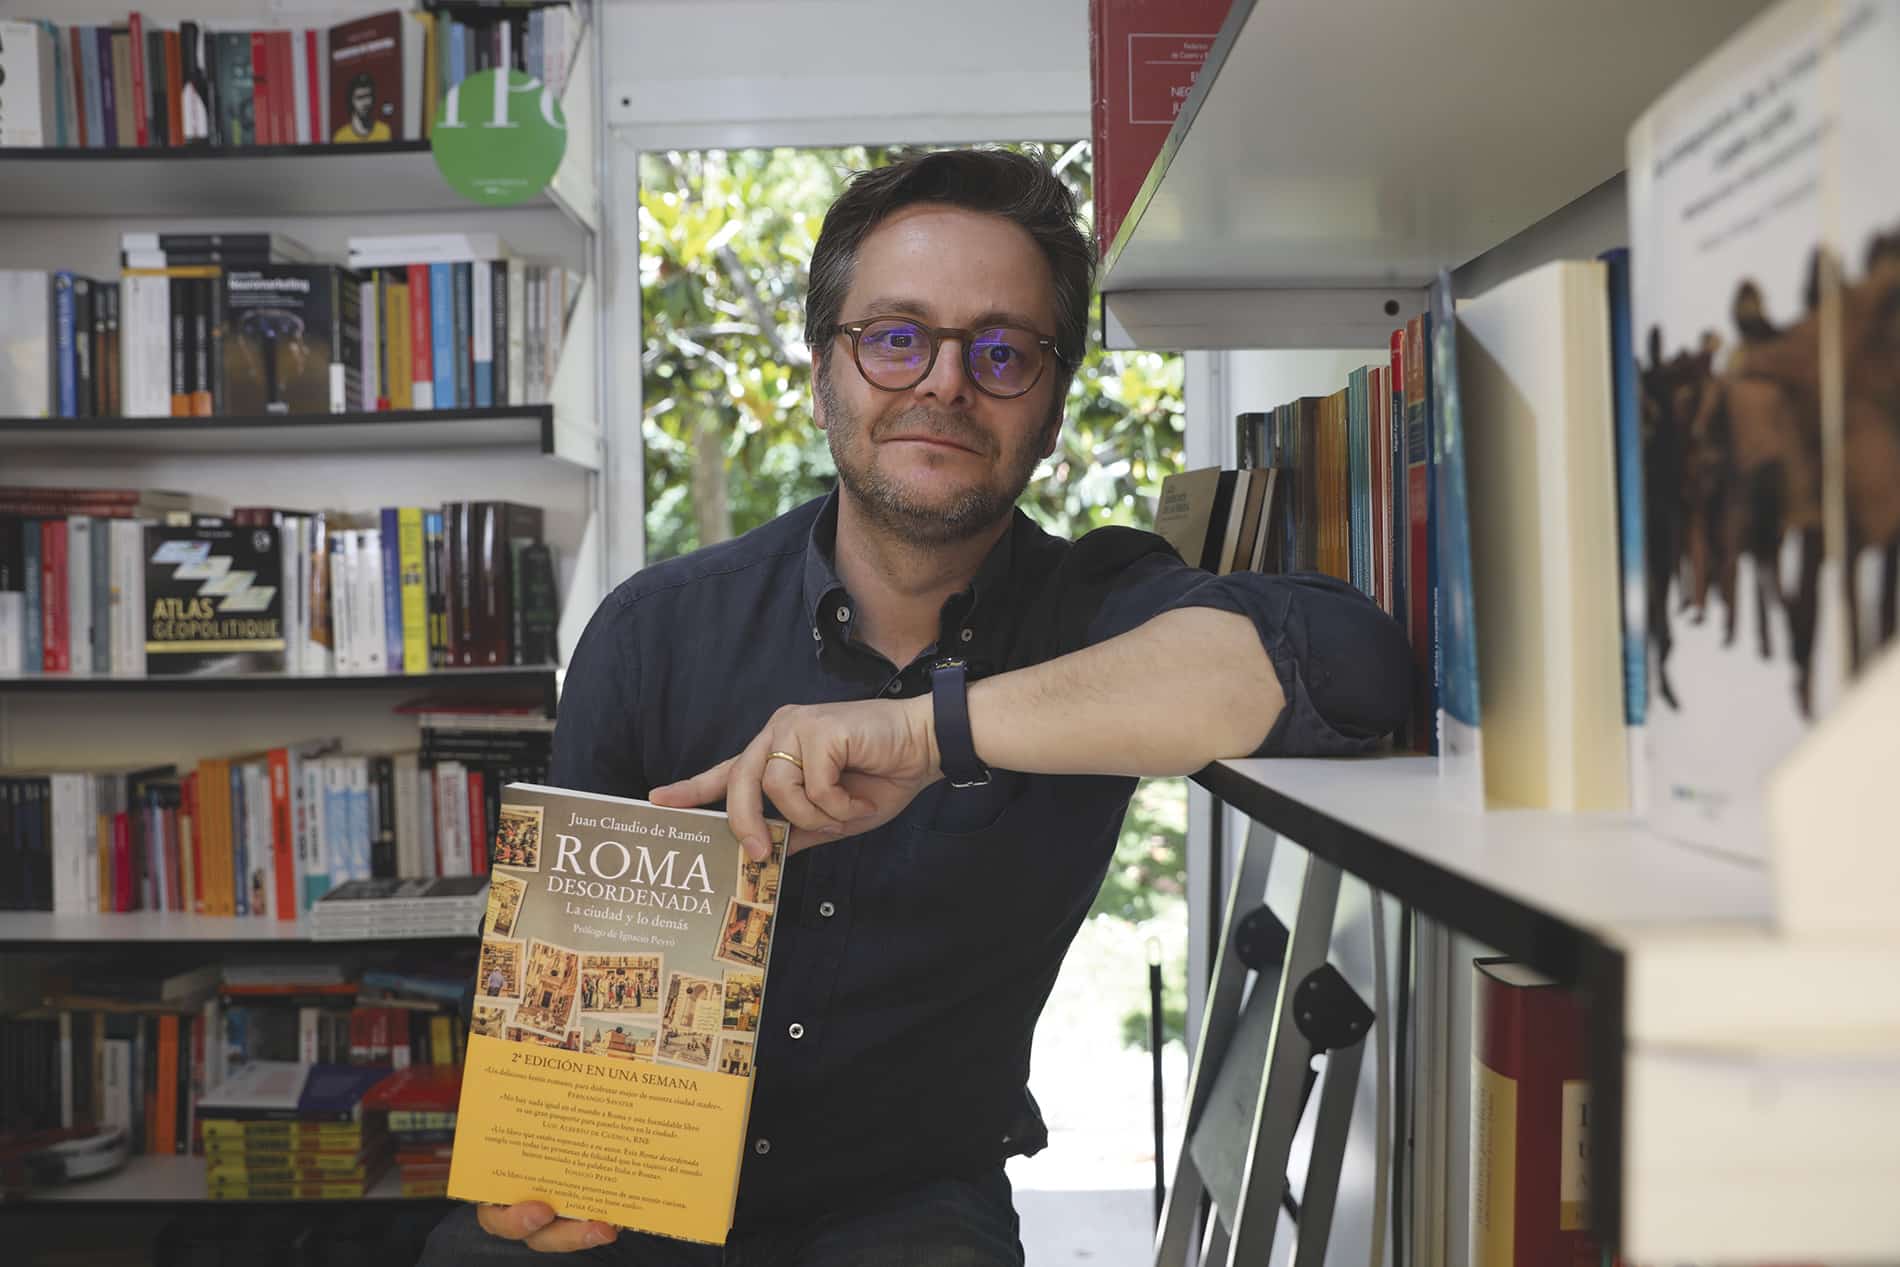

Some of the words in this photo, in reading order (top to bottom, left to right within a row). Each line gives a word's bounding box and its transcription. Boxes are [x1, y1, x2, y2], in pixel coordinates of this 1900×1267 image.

[153, 597, 214, 619] ATLAS
[568, 812, 597, 829] Juan
[599, 816, 648, 834] Claudio
[650, 823, 665, 837] de
[668, 826, 711, 844] Ramón
[551, 832, 715, 893] ROMA
[547, 875, 713, 915] DESORDENADA
[566, 902, 580, 915] La
[583, 904, 622, 921] ciudad
[624, 914, 633, 926] y
[636, 912, 649, 925] lo
[651, 914, 689, 931] demás
[511, 1052, 521, 1063] 2ª
[524, 1053, 583, 1073] EDICIÓN
[586, 1064, 605, 1076] EN
[608, 1068, 639, 1082] UNA
[641, 1073, 698, 1091] SEMANA
